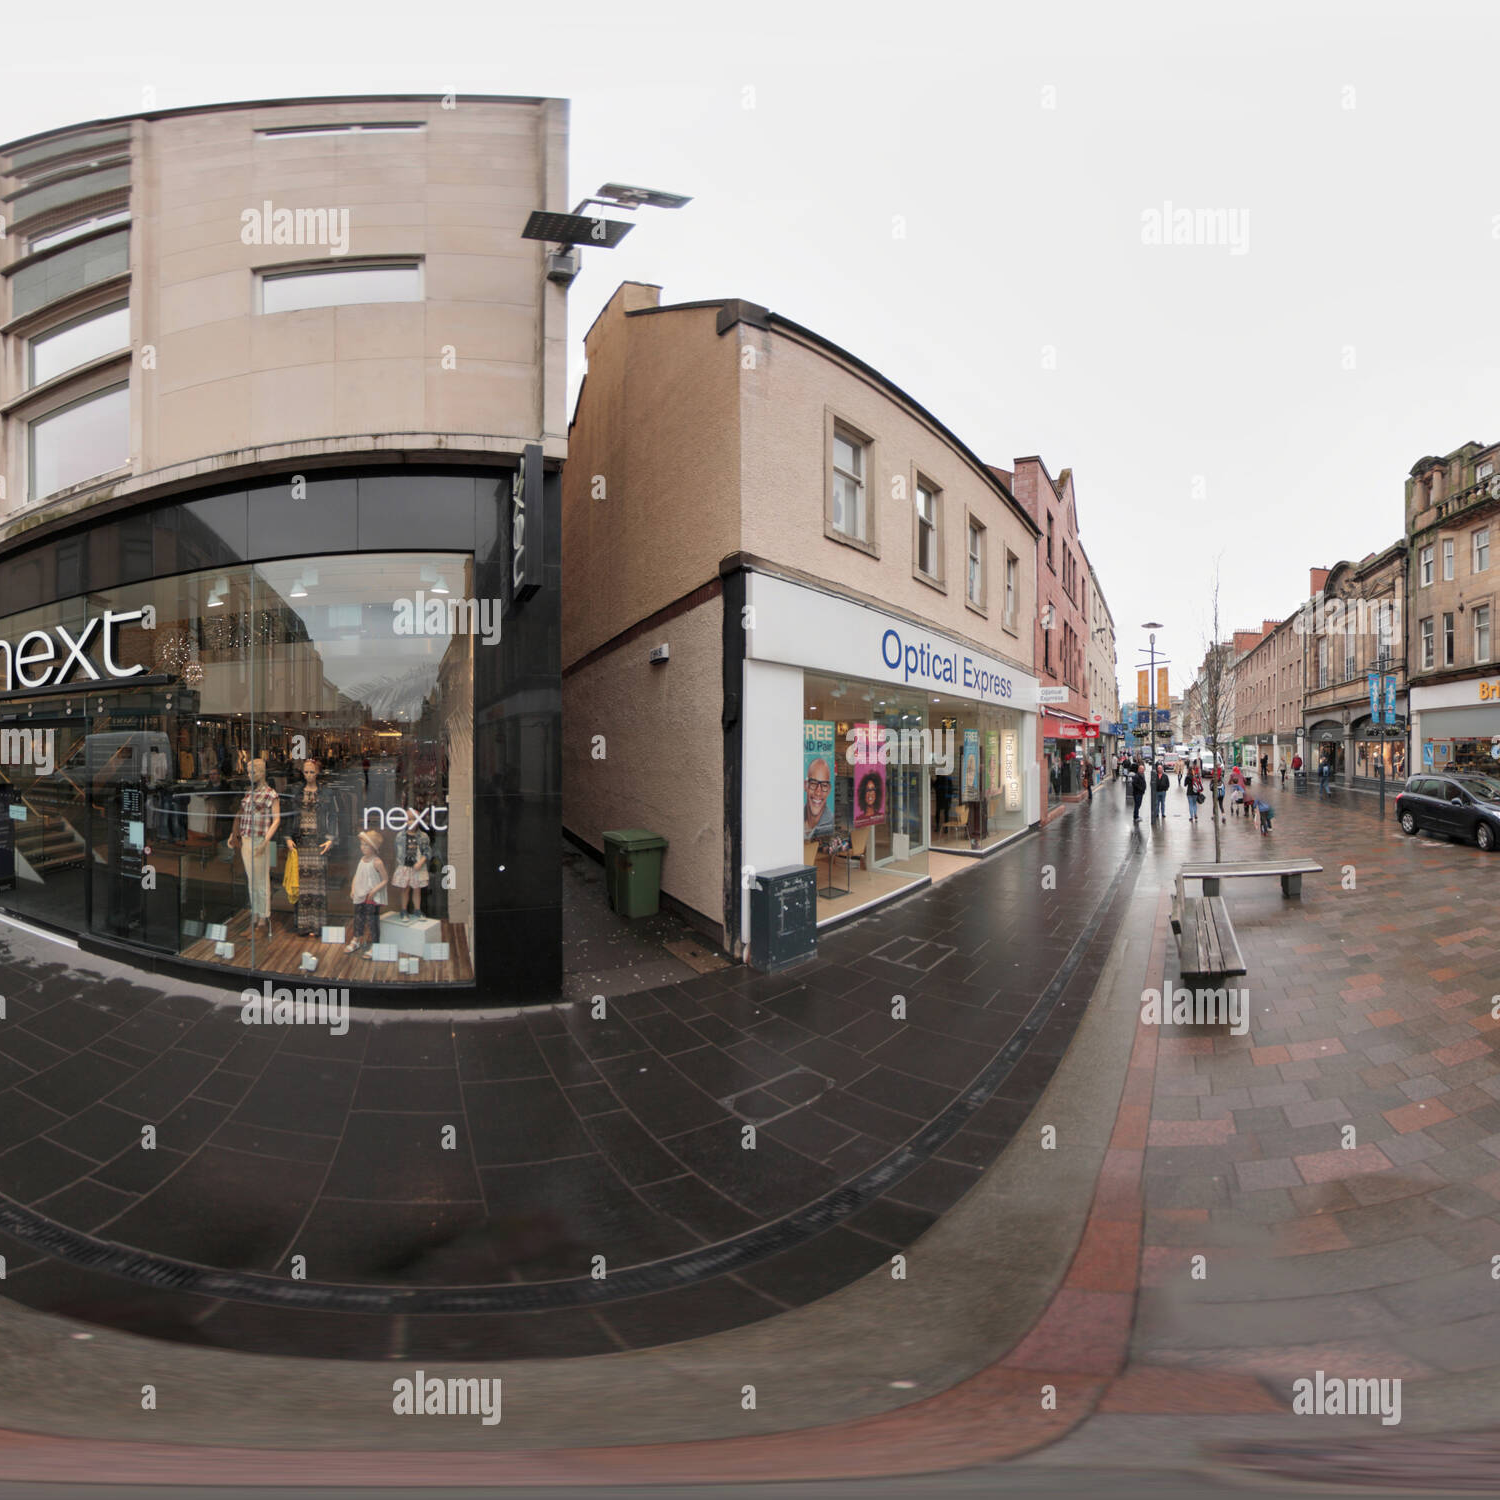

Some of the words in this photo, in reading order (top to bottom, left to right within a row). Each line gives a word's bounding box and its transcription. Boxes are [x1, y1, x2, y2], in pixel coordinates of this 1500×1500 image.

[882, 629, 957, 684] Optical
[963, 657, 1012, 698] Express
[817, 742, 833, 752] Pair
[1005, 733, 1014, 750] The
[1005, 753, 1014, 780] Laser
[363, 806, 448, 831] next
